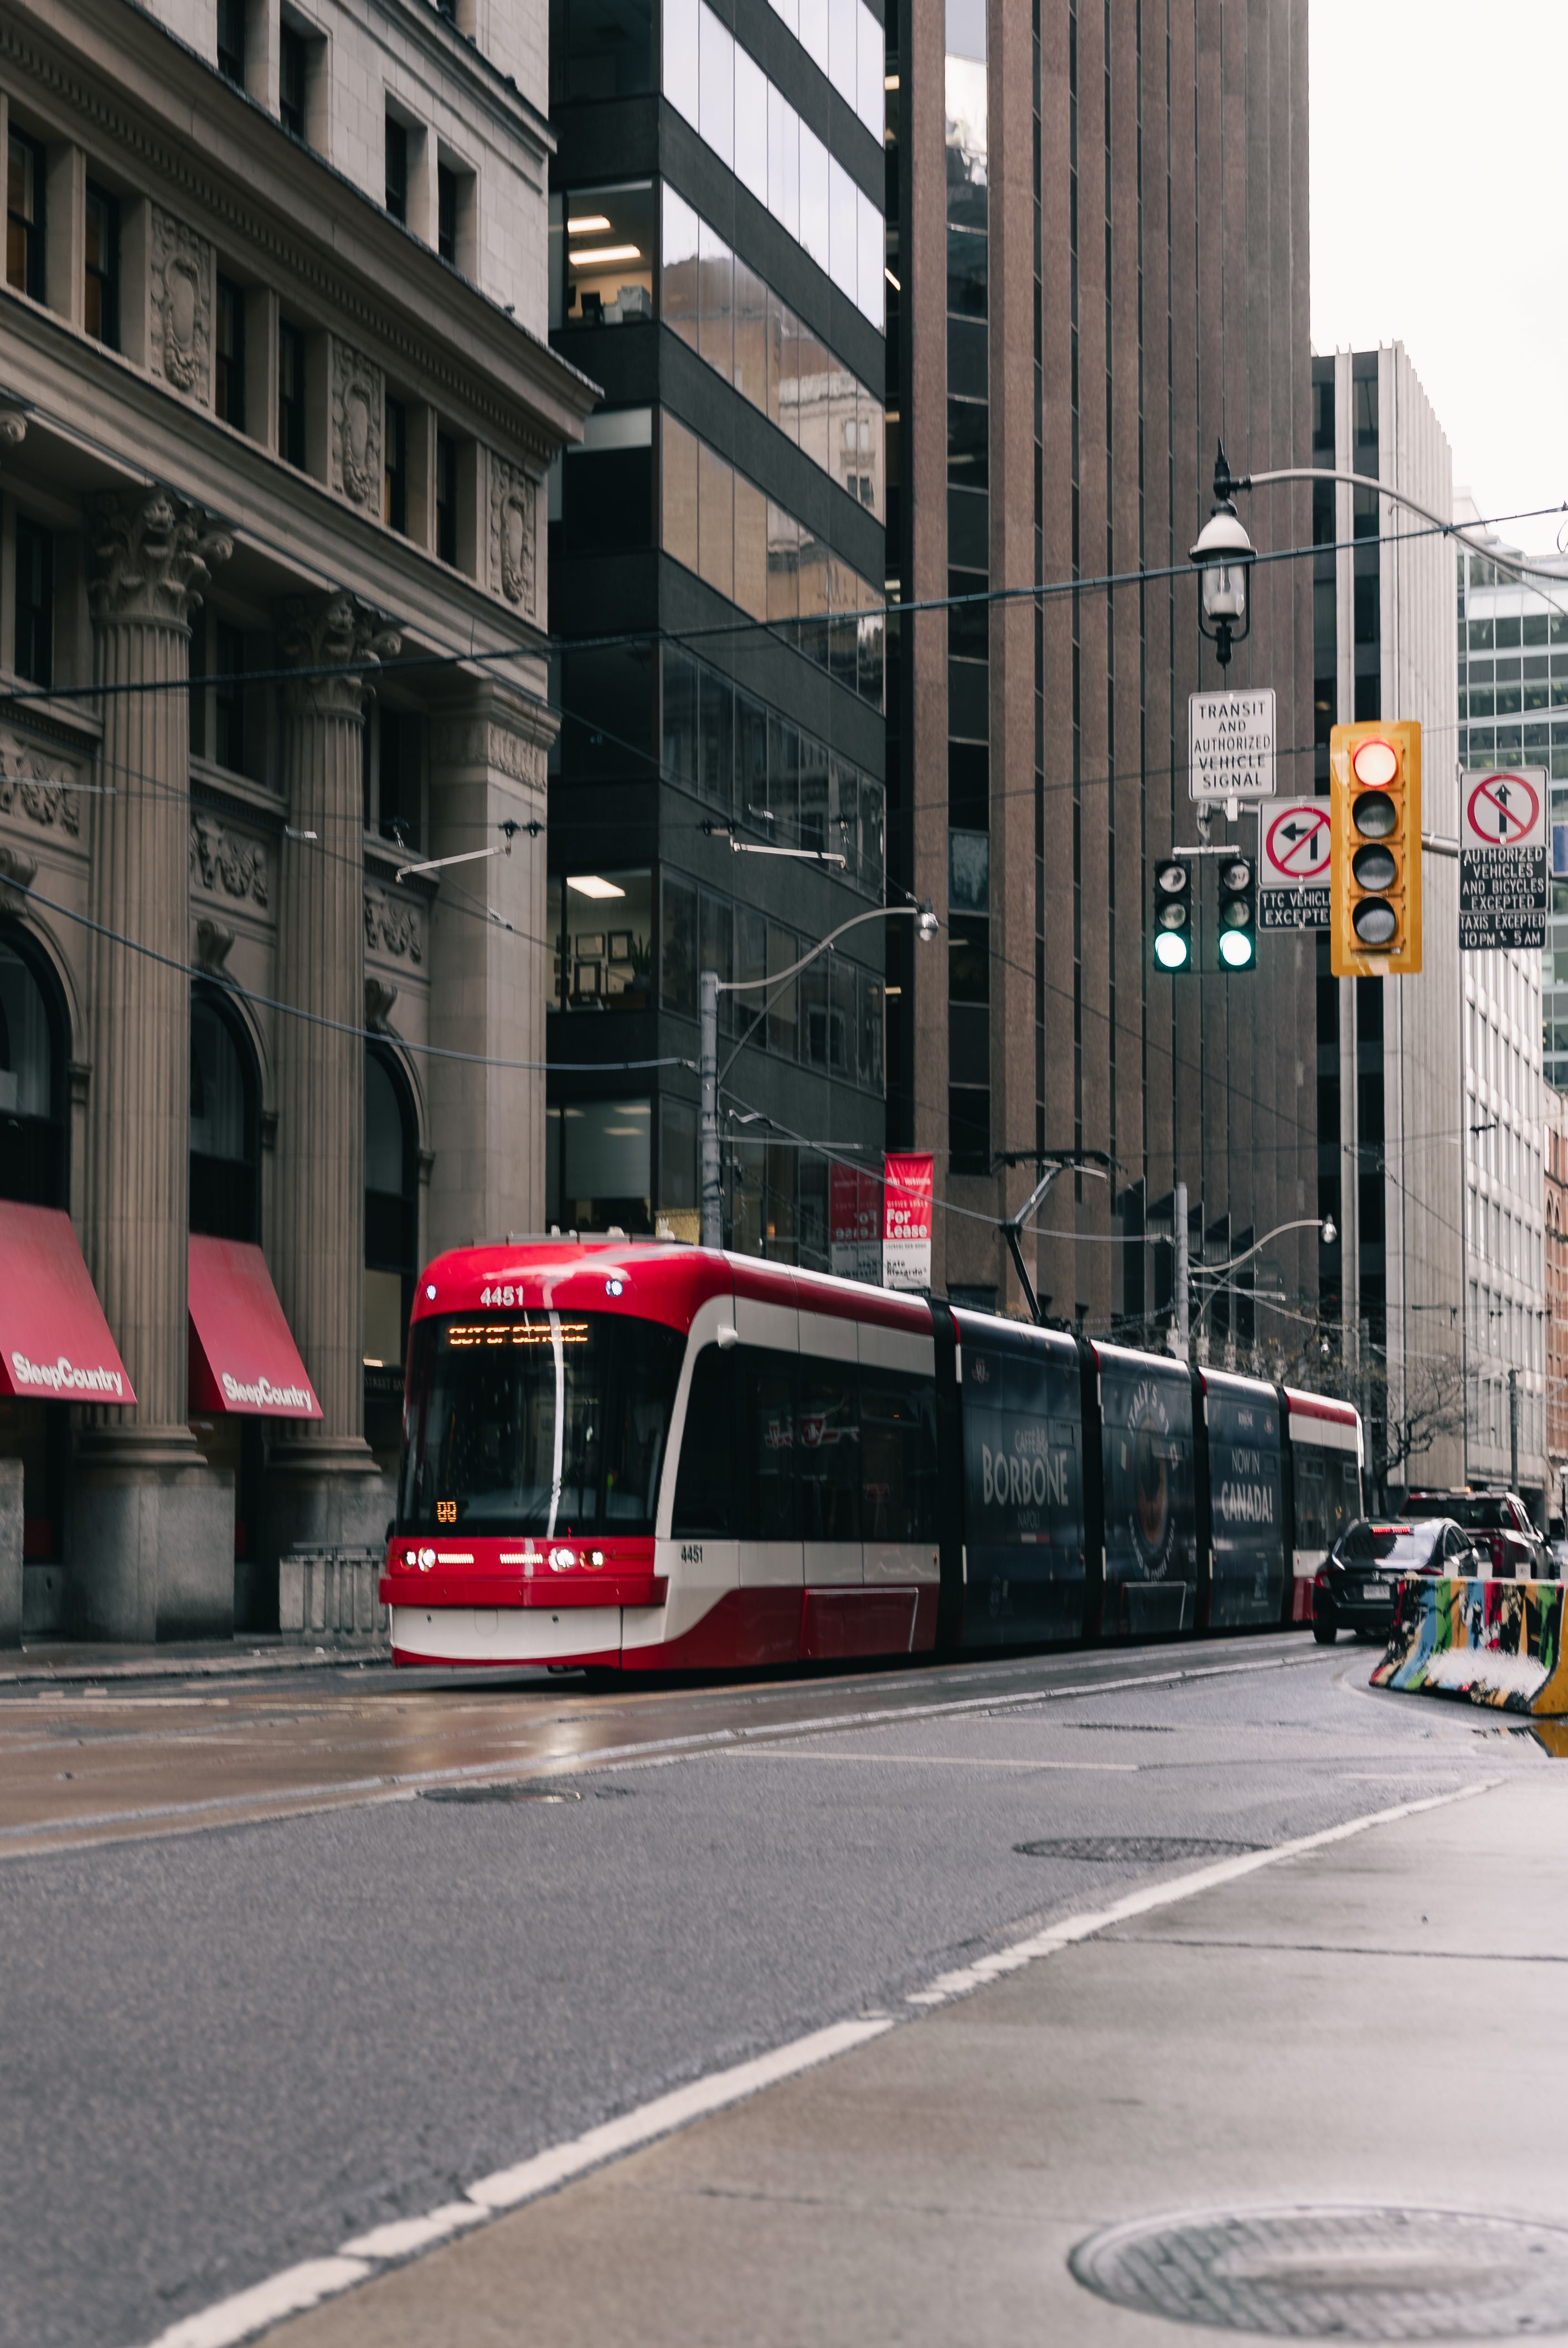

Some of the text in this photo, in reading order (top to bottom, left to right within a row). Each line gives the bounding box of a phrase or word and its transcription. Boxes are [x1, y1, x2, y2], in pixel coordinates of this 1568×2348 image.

[1199, 701, 1265, 719] TRANSIT
[1219, 719, 1246, 734] AND
[1194, 734, 1270, 754] AUTHORIZED
[1199, 753, 1265, 771] VEHICLE
[1203, 771, 1262, 790] SIGNAL
[1464, 847, 1543, 864] AUTHORIZED
[1473, 862, 1534, 879] VEHICLES
[1462, 877, 1544, 896] AND BICYCLES
[1262, 890, 1330, 908] TTC VEHICL
[1471, 894, 1535, 911] EXCEPTED
[1265, 908, 1331, 925] EXCEPTE
[1461, 913, 1545, 930] TAXIS EXCEPTED
[1464, 931, 1477, 948] 10
[1479, 931, 1495, 947] PM
[1514, 930, 1522, 946] 5
[1524, 931, 1540, 946] AM
[886, 1208, 911, 1224] For
[886, 1223, 927, 1238] Lease
[480, 1285, 523, 1307] 4451
[1231, 1447, 1260, 1476] NOW IN
[982, 1442, 1069, 1506] BORBONE
[1221, 1480, 1273, 1524] CANADA!
[681, 1544, 703, 1564] 4451
